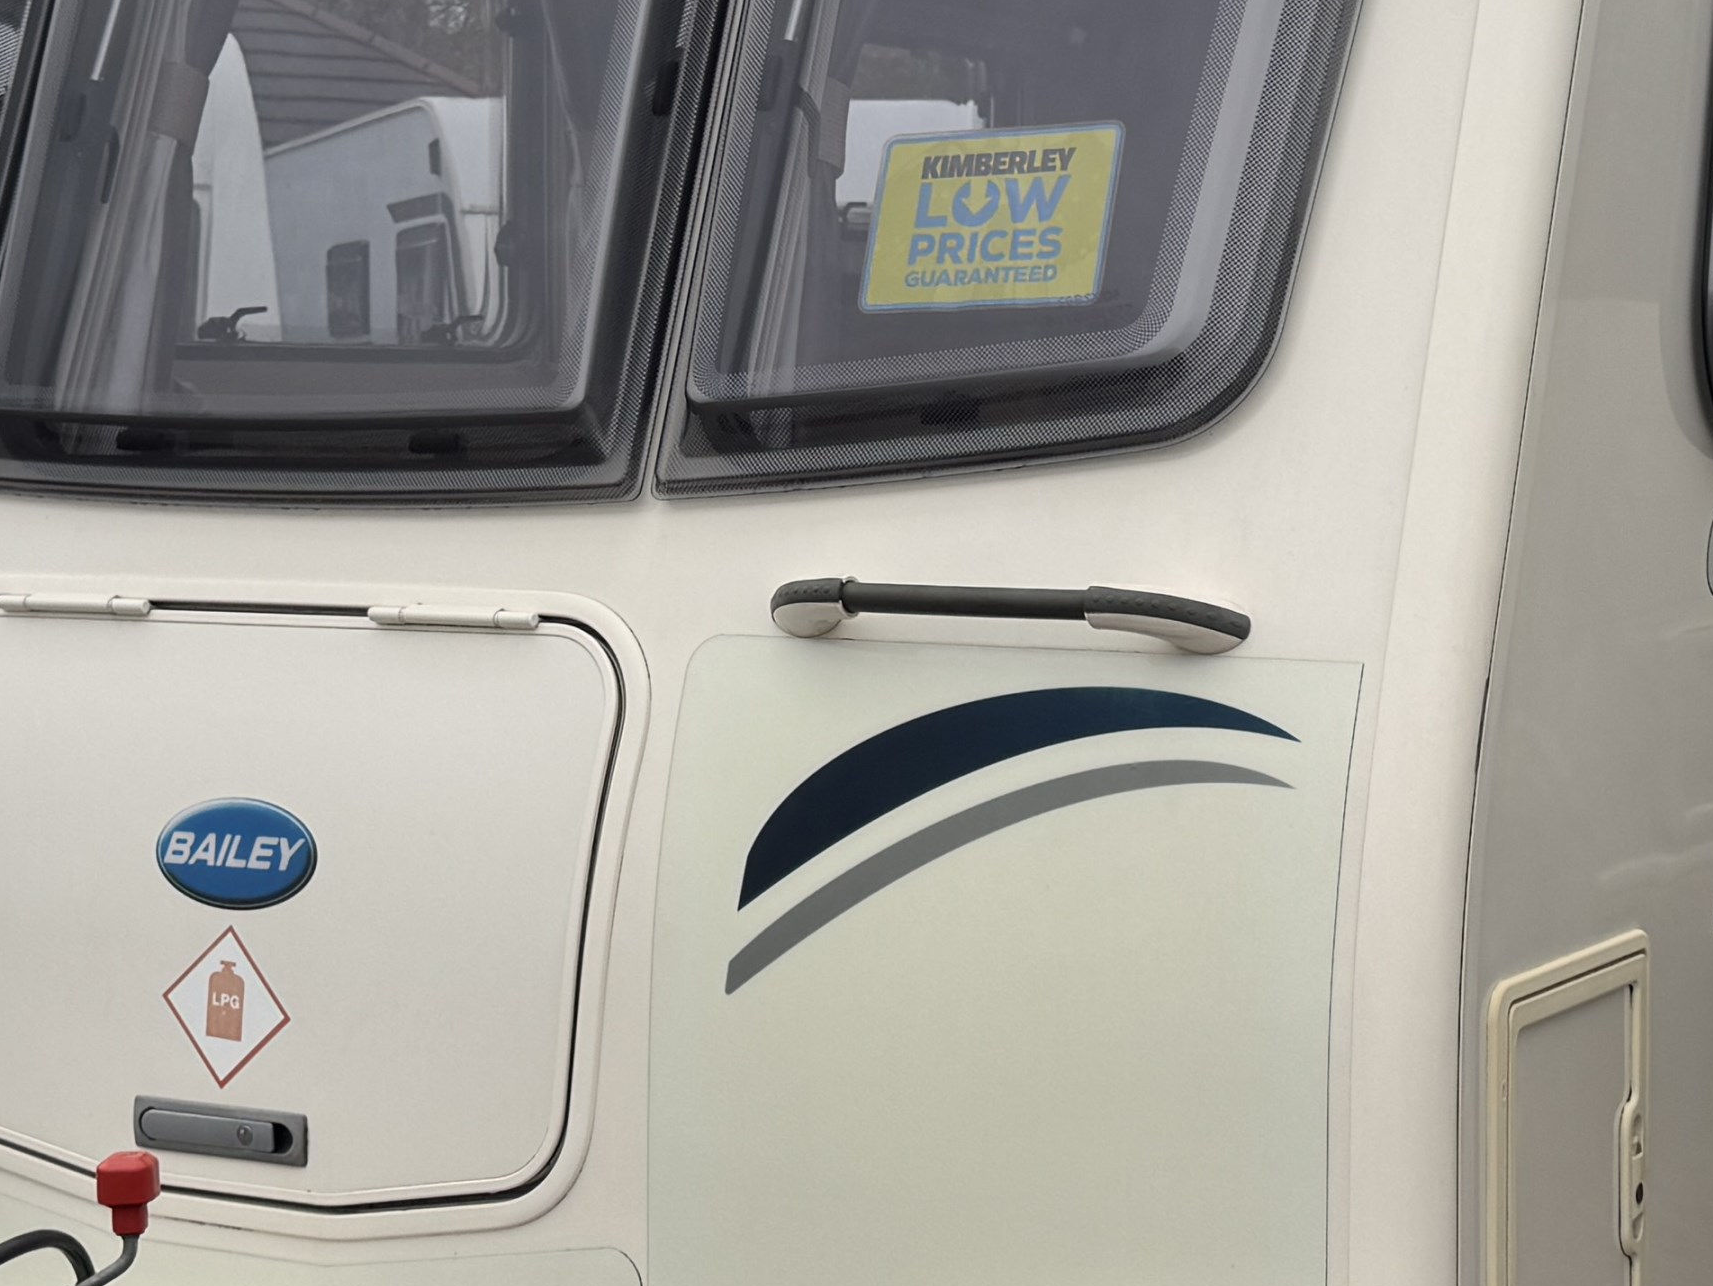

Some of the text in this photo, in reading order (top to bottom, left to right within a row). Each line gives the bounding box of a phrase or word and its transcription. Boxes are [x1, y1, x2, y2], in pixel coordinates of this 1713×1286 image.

[921, 147, 1077, 180] KIMBERLEY
[914, 174, 1072, 229] LOW
[907, 227, 1064, 266] PRICES
[905, 265, 1058, 288] GUARANTEED
[163, 830, 306, 872] BAILEY
[212, 991, 240, 1009] LPG
